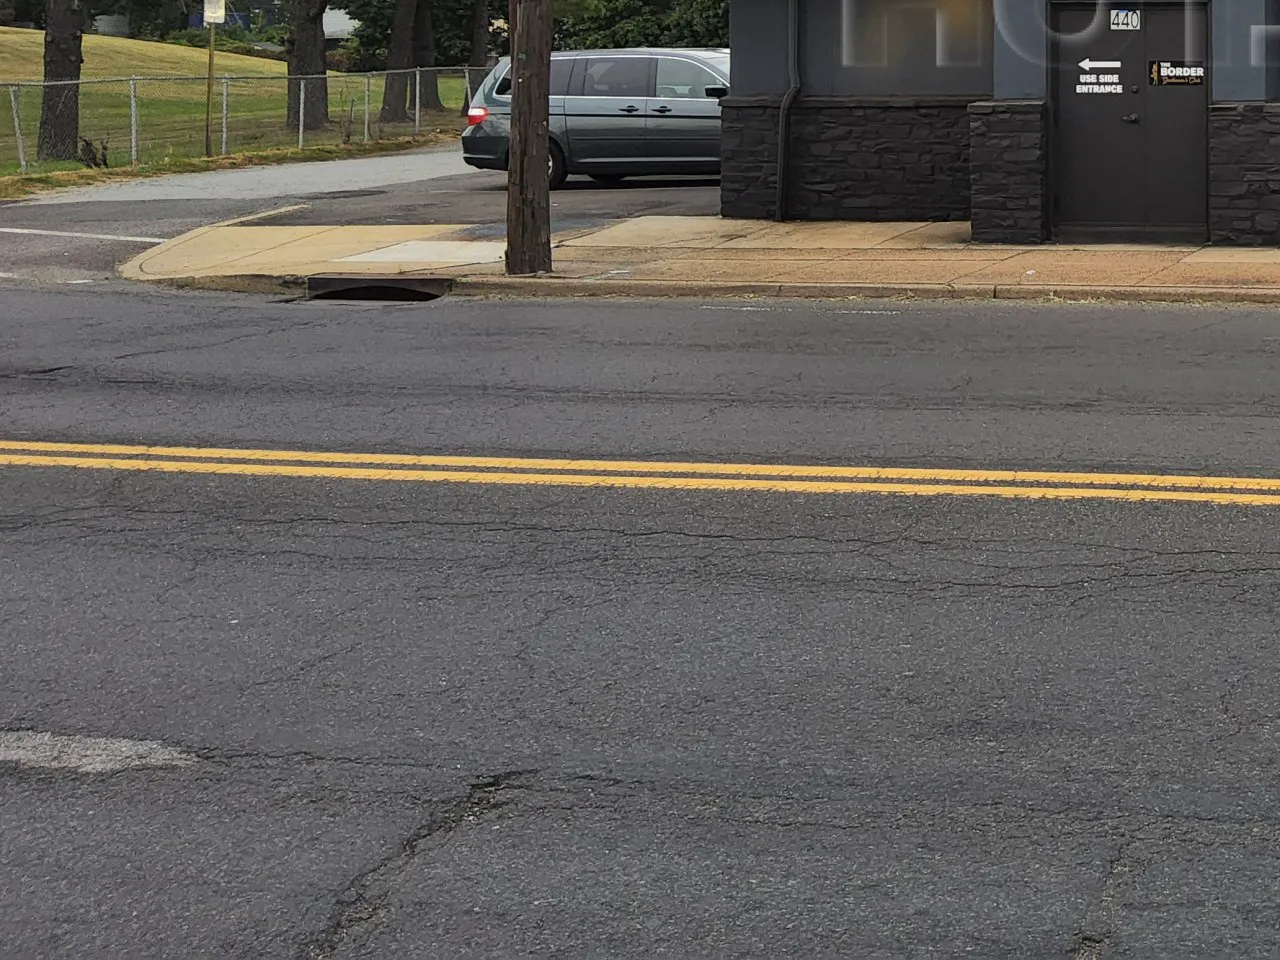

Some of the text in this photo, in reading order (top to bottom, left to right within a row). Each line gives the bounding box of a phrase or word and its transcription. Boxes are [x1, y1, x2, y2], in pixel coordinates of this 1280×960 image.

[1111, 11, 1139, 28] 440
[1160, 67, 1204, 76] BORDER
[1079, 74, 1119, 83] USE SIDE
[1075, 84, 1123, 94] ENTRANCE
